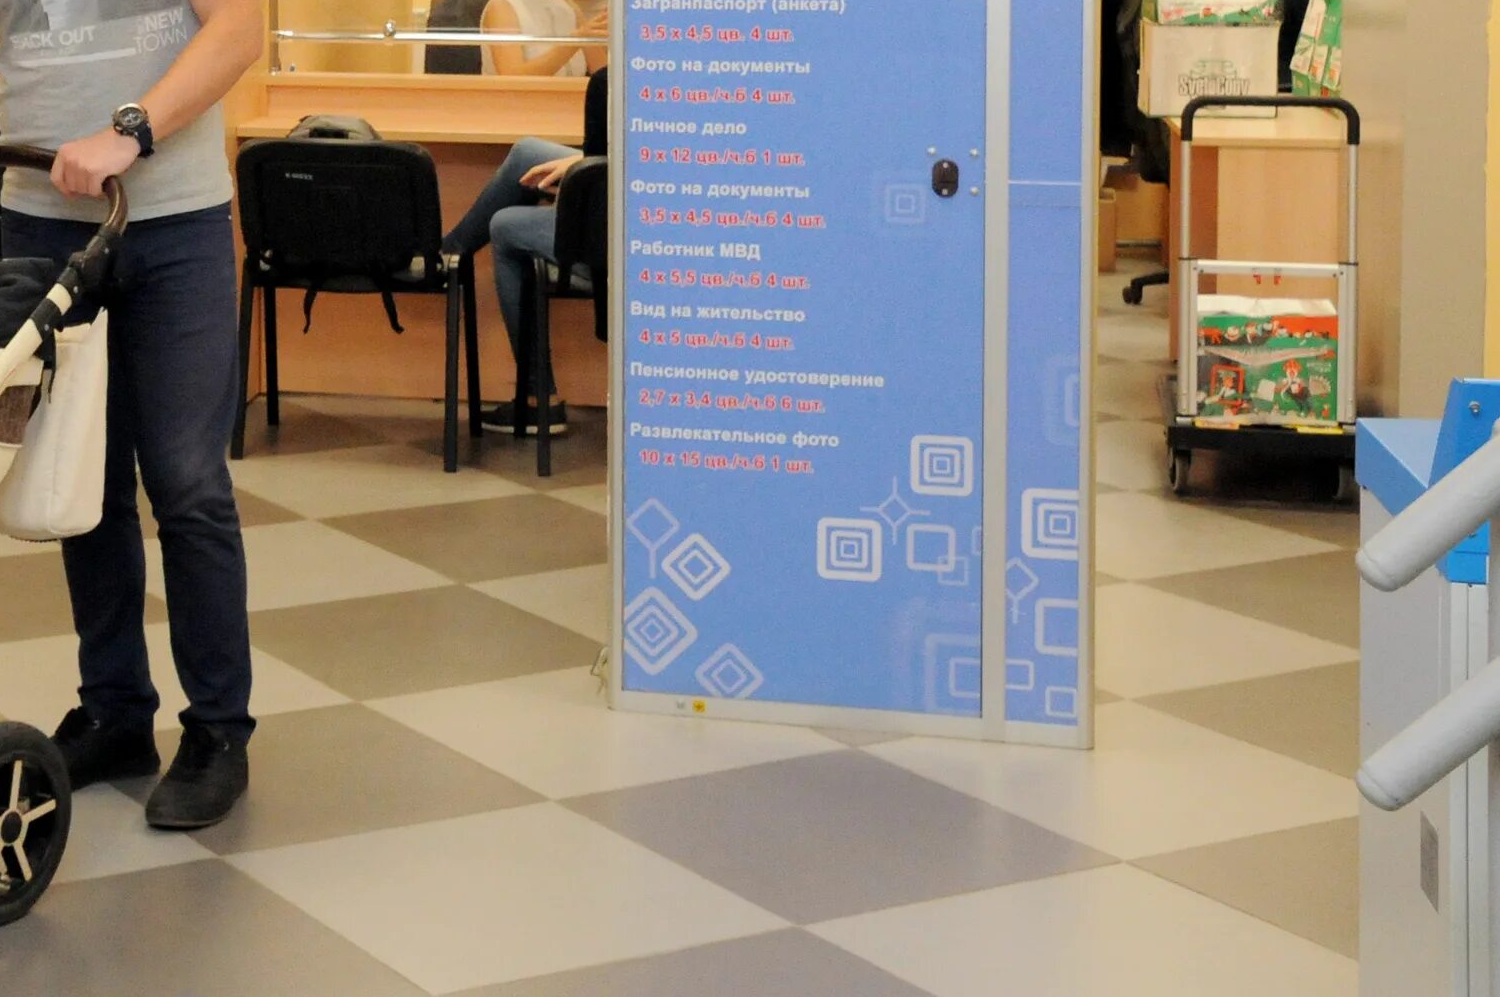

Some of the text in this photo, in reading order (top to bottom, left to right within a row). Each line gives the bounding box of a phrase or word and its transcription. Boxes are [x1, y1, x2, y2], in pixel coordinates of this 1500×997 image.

[59, 25, 95, 46] OUT
[133, 25, 188, 54] TOWN
[640, 26, 666, 42] 3,5
[687, 26, 712, 43] 4,5
[718, 29, 745, 42] цв.
[751, 27, 760, 40] 4
[766, 30, 794, 41] шт.
[631, 57, 810, 76] Фото на документы
[640, 87, 650, 100] 4
[671, 87, 681, 100] 6
[752, 88, 762, 102] 4
[768, 91, 796, 104] шт.
[630, 118, 747, 136] Личное дело
[640, 148, 650, 163] 9
[672, 148, 691, 163] 12
[763, 150, 771, 164] 1
[777, 153, 805, 166] шт.
[630, 180, 810, 199] Фото на документы
[640, 208, 666, 224] 3,5
[686, 210, 712, 226] 4,5
[782, 213, 792, 226] 4
[797, 215, 826, 228] шт.
[631, 240, 760, 260] Работник МВД
[640, 269, 650, 282] 4
[671, 270, 696, 286] 5,5
[767, 273, 777, 286] 4
[781, 276, 811, 289] шт.
[631, 301, 805, 322] Вид на жительство
[640, 329, 650, 343] 4
[670, 331, 681, 344] 5
[751, 334, 761, 348] 4
[765, 336, 794, 349] шт.
[630, 362, 884, 388] Пенсионное удостоверение
[639, 390, 665, 406] 2,7
[686, 392, 711, 407] 3,4
[781, 396, 792, 410] 6
[797, 399, 825, 412] шт.
[630, 423, 839, 448] Развлекательное фото
[639, 450, 659, 464] 10
[680, 452, 700, 466] 15
[772, 456, 779, 470] 1
[786, 459, 814, 472] шт.
